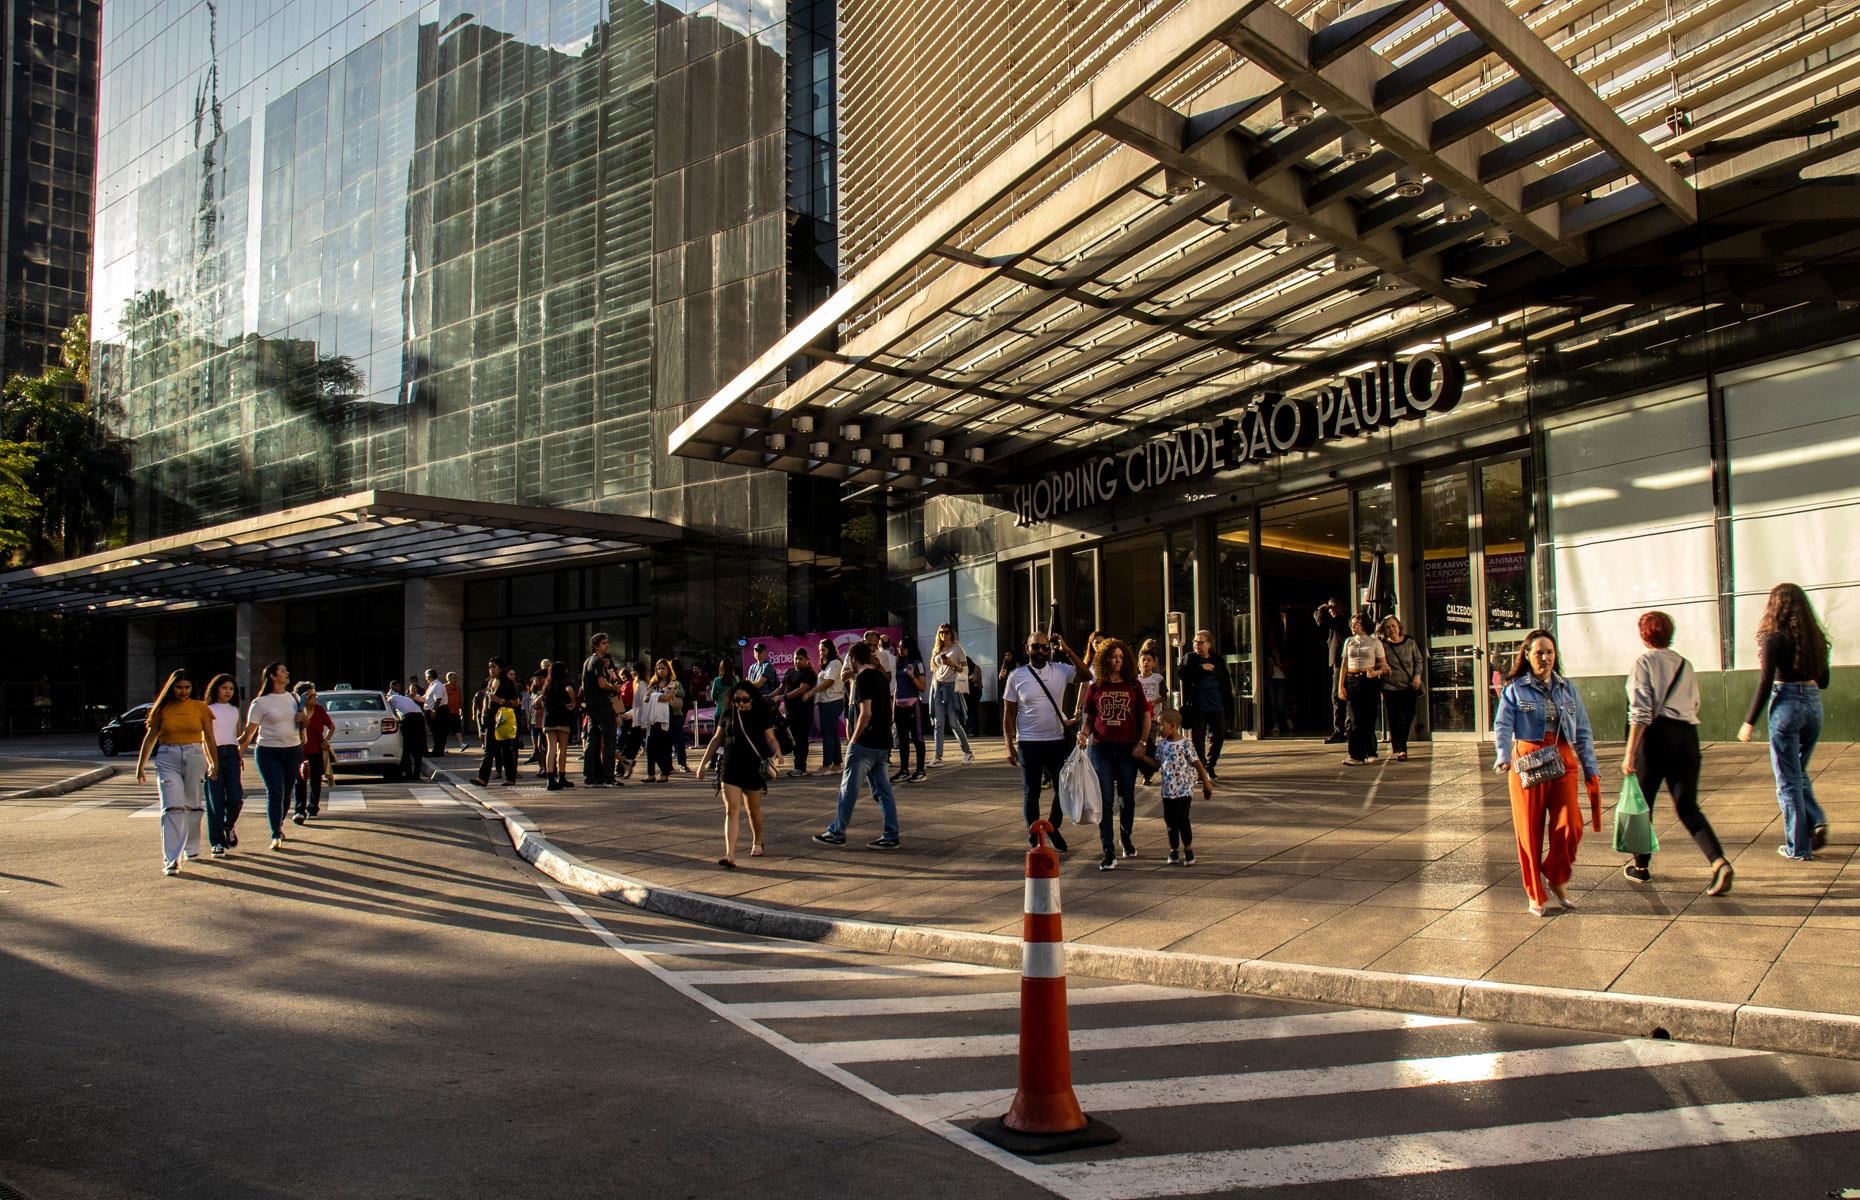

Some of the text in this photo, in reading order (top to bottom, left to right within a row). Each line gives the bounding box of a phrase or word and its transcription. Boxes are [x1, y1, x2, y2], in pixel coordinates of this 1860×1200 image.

[1013, 350, 1444, 528] SHOPPING CIDADE SÃO PAULO
[1425, 560, 1470, 570] DREAMWO
[767, 651, 793, 665] Barbie
